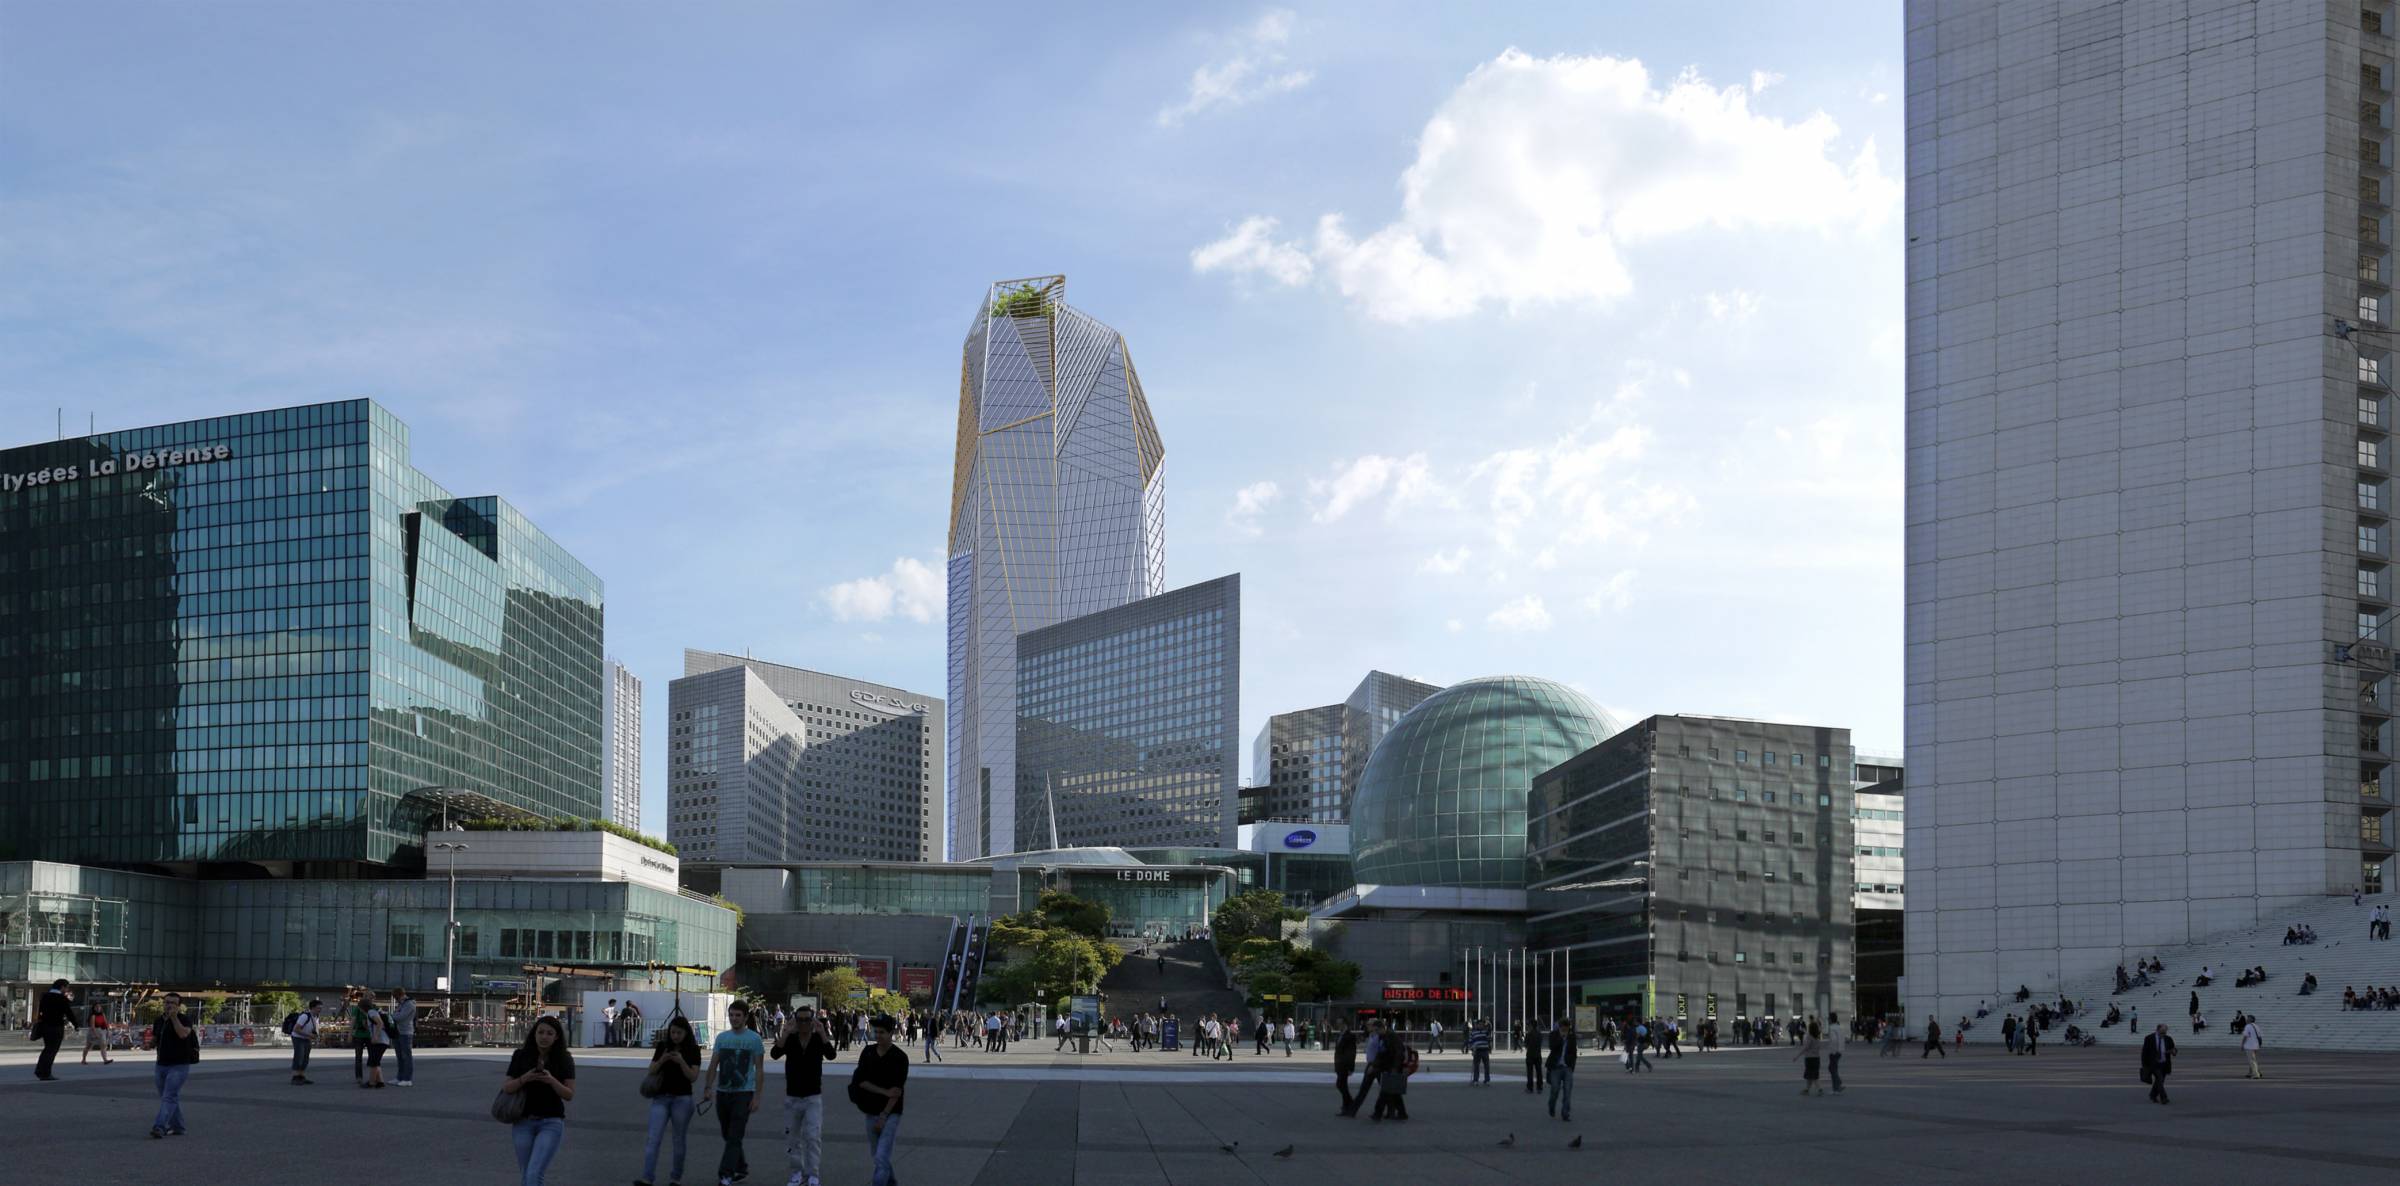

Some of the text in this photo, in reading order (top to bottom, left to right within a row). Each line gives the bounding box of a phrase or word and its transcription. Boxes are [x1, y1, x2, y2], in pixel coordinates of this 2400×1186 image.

[0, 445, 230, 492] lysées La Défense
[850, 690, 887, 702] GDF
[1117, 870, 1170, 881] LE DOME
[1384, 989, 1424, 1000] BISTRO
[1428, 989, 1442, 1000] DE
